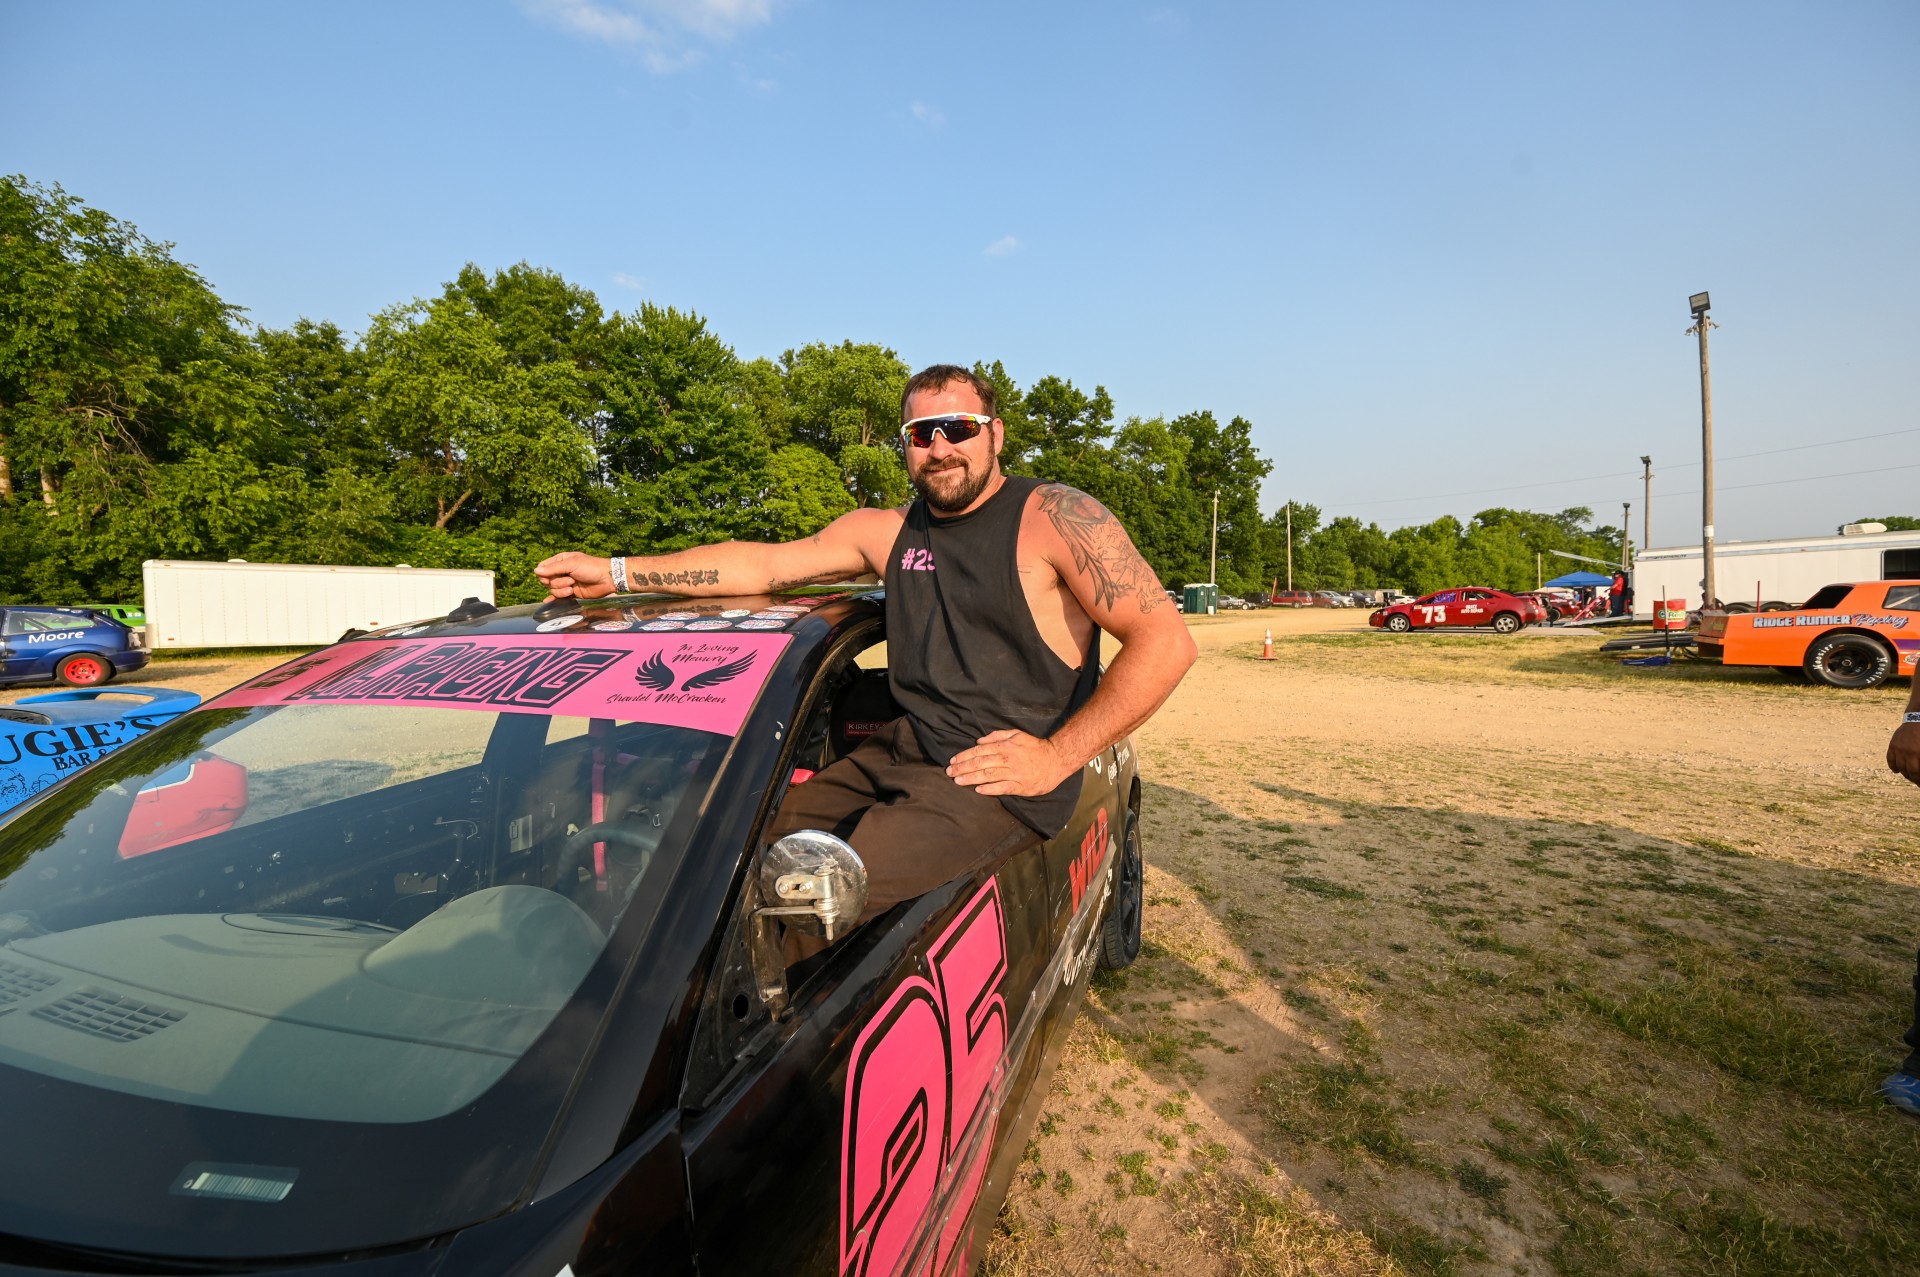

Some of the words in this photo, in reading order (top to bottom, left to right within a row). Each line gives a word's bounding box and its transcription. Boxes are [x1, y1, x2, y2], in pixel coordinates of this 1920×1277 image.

[1421, 606, 1446, 623] 73
[1753, 616, 1793, 628] RIDGE
[1795, 614, 1851, 627] RUNNER
[28, 629, 85, 644] Moore
[677, 643, 694, 653] In
[694, 643, 740, 655] Loving
[1813, 643, 1834, 670] Hoosier
[671, 653, 728, 667] Memory
[401, 642, 634, 709] RACING
[654, 692, 727, 704] McCracken
[52, 751, 93, 771] BAR
[1069, 808, 1108, 915] WILD
